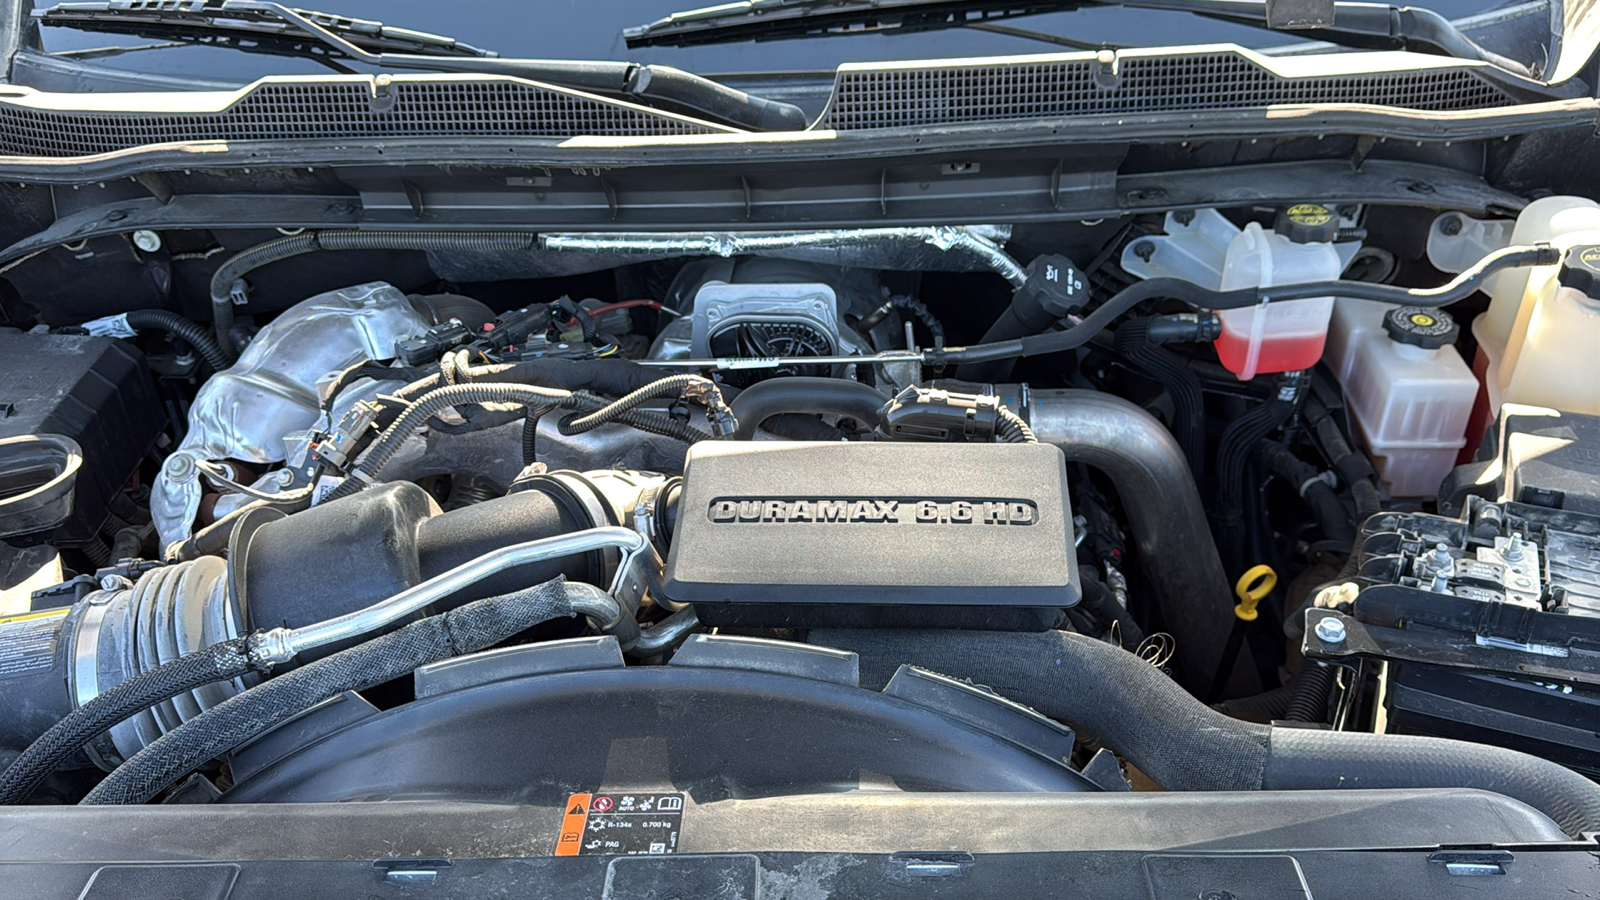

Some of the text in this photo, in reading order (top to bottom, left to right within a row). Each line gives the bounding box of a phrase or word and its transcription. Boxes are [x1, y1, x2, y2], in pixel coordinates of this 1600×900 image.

[713, 499, 1034, 525] DURAMAX 6.6 HD
[662, 821, 672, 829] kg
